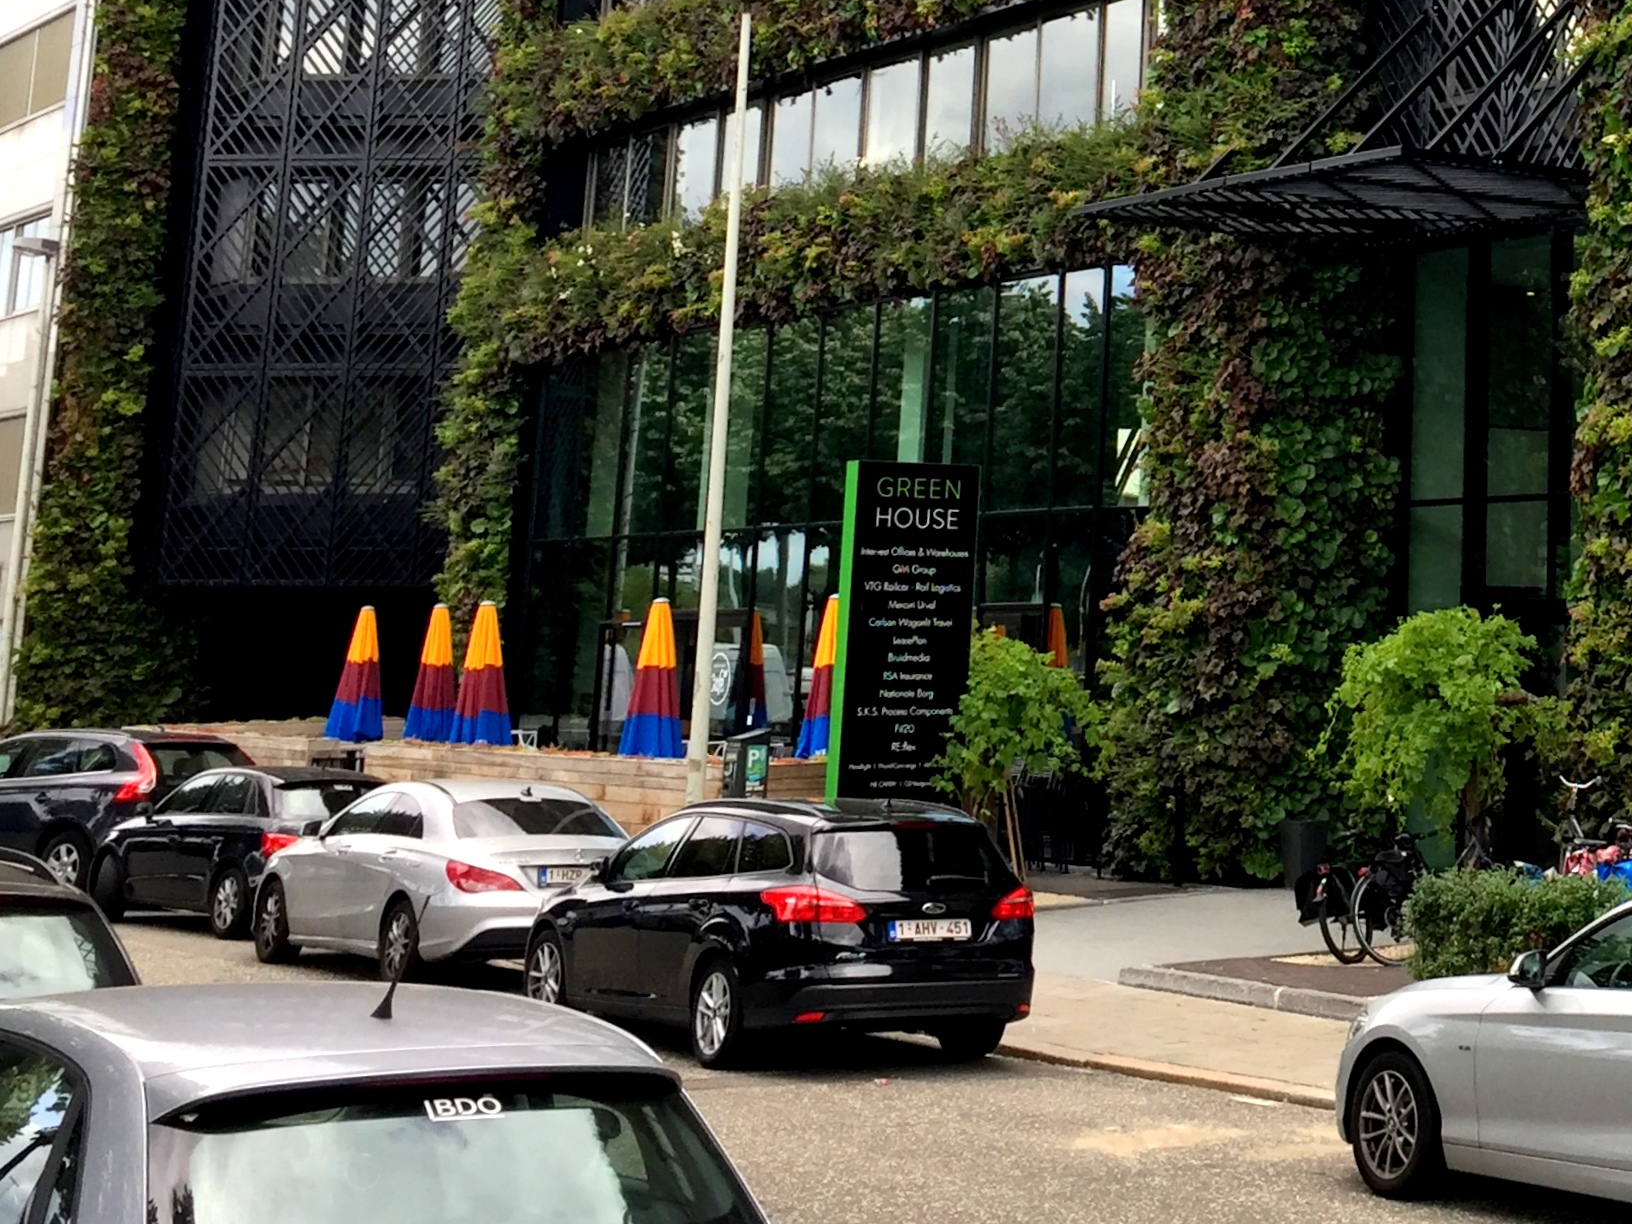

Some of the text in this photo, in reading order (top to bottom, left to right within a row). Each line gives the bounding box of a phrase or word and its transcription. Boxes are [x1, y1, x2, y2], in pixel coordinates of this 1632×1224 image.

[876, 476, 962, 500] GREEN
[875, 506, 961, 530] HOUSE
[911, 564, 937, 577] Group
[864, 580, 883, 592] VTG
[747, 749, 760, 768] P
[432, 1096, 503, 1117] BDO
